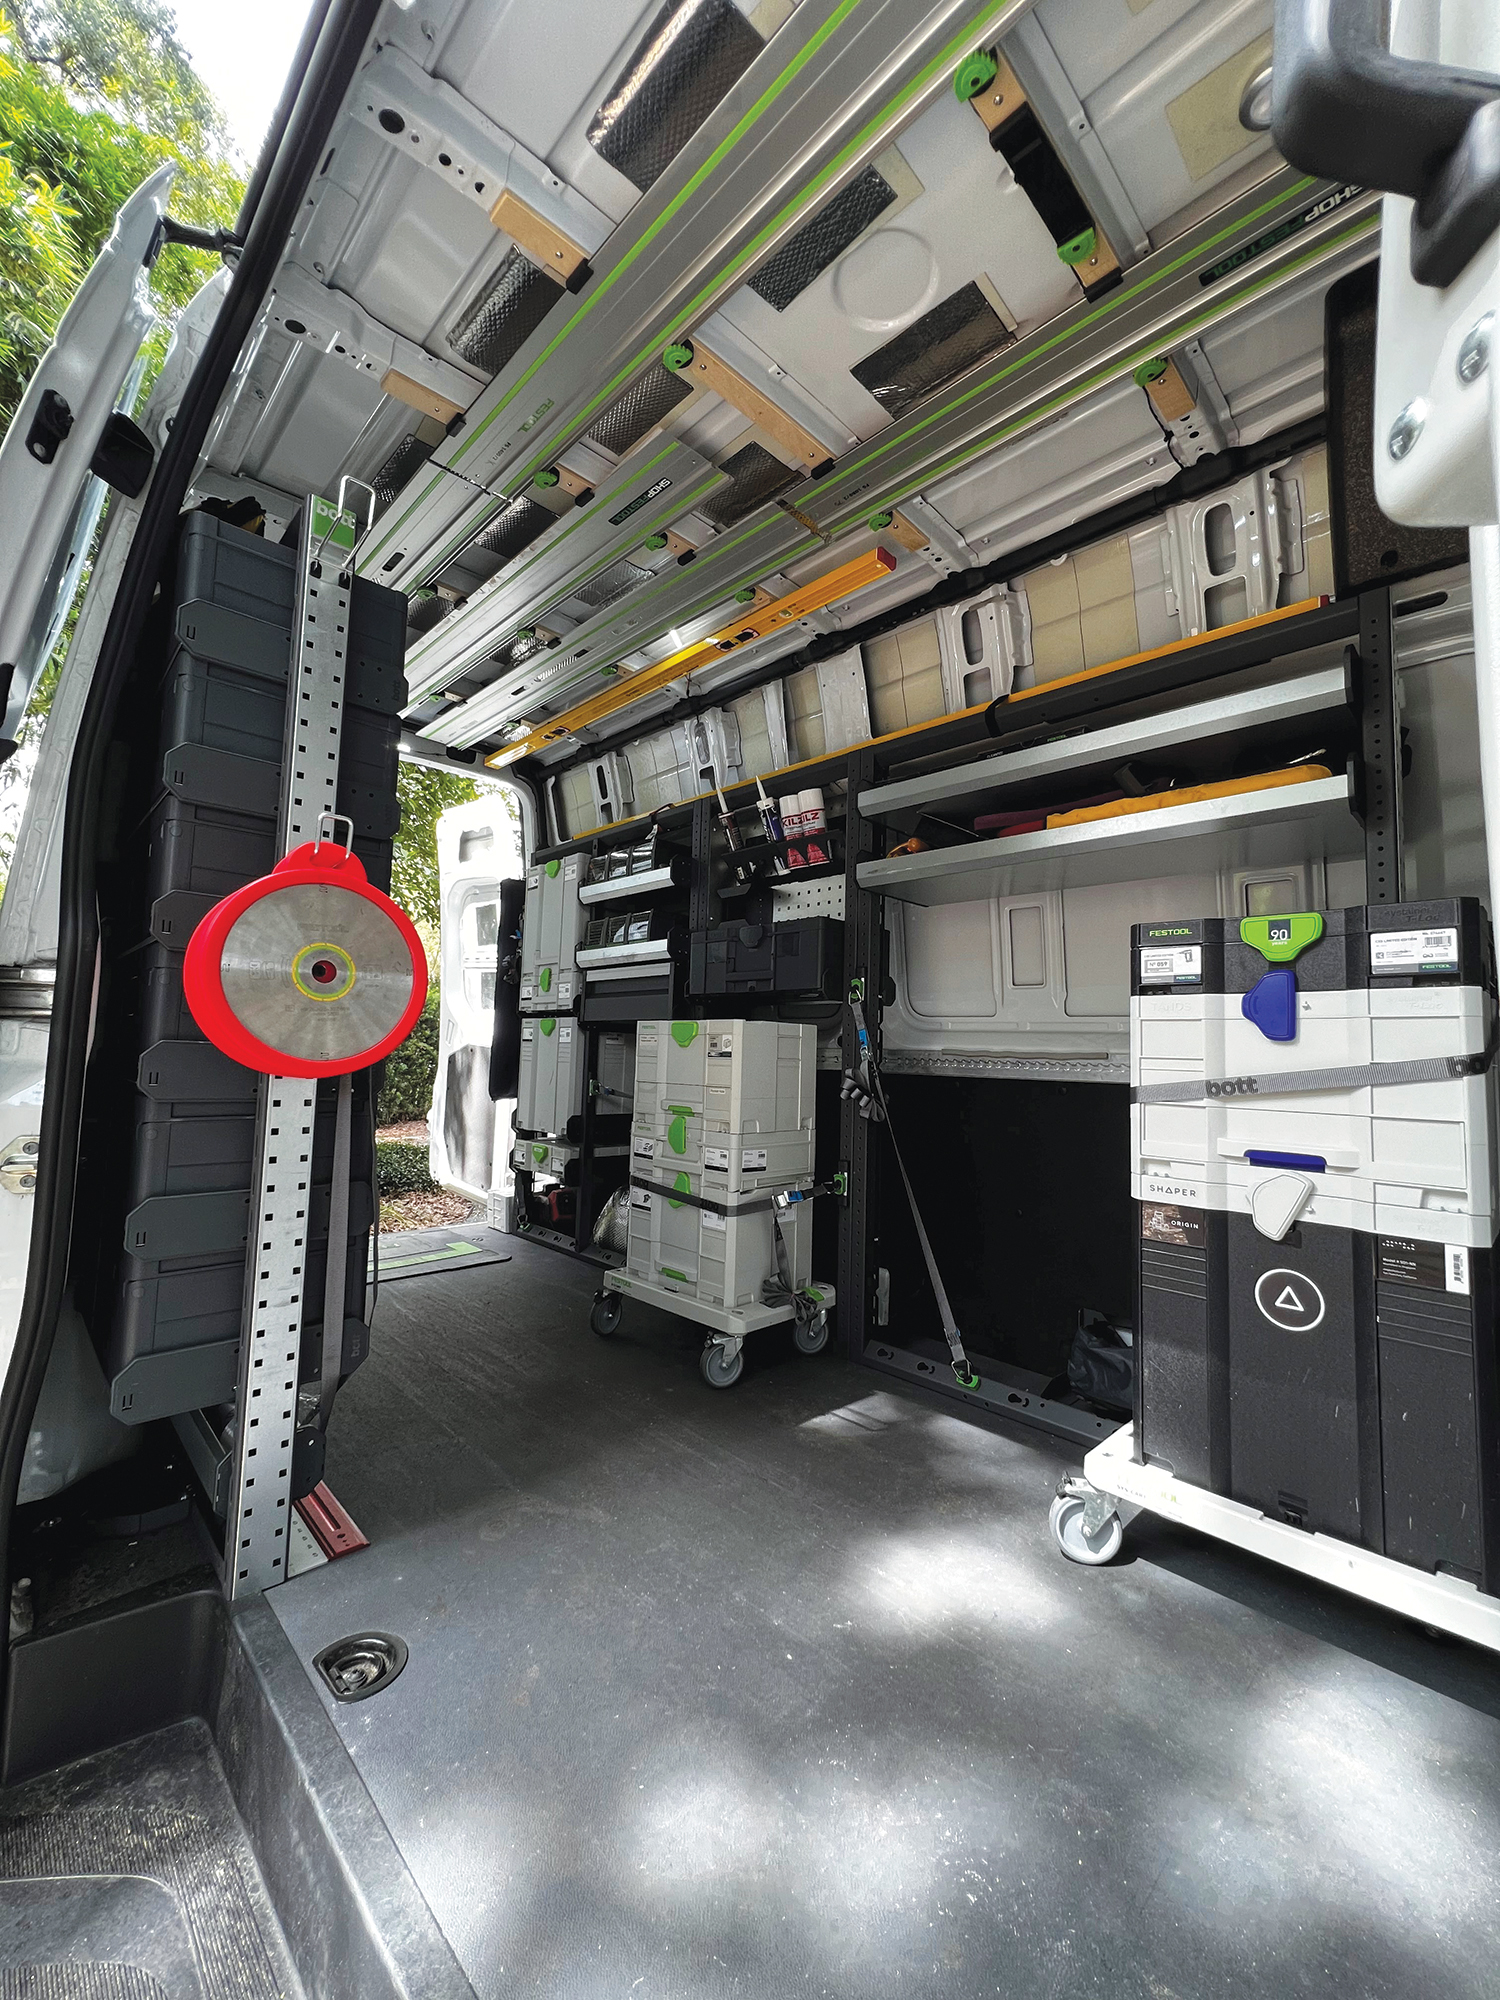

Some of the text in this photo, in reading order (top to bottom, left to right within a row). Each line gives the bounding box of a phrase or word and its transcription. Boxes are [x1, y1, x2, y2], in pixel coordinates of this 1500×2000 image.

[1205, 217, 1305, 279] FESTOOL
[517, 398, 555, 432] FESTOOL
[611, 479, 671, 522] SHOP FESTOOL
[316, 501, 356, 529] bott
[1149, 927, 1192, 937] FESTOOL
[1270, 928, 1288, 941] 90
[1205, 1076, 1259, 1097] bott
[1149, 1184, 1196, 1198] SHAPER
[1171, 1219, 1199, 1230] ORIGIN
[611, 1276, 632, 1288] FESTOOL
